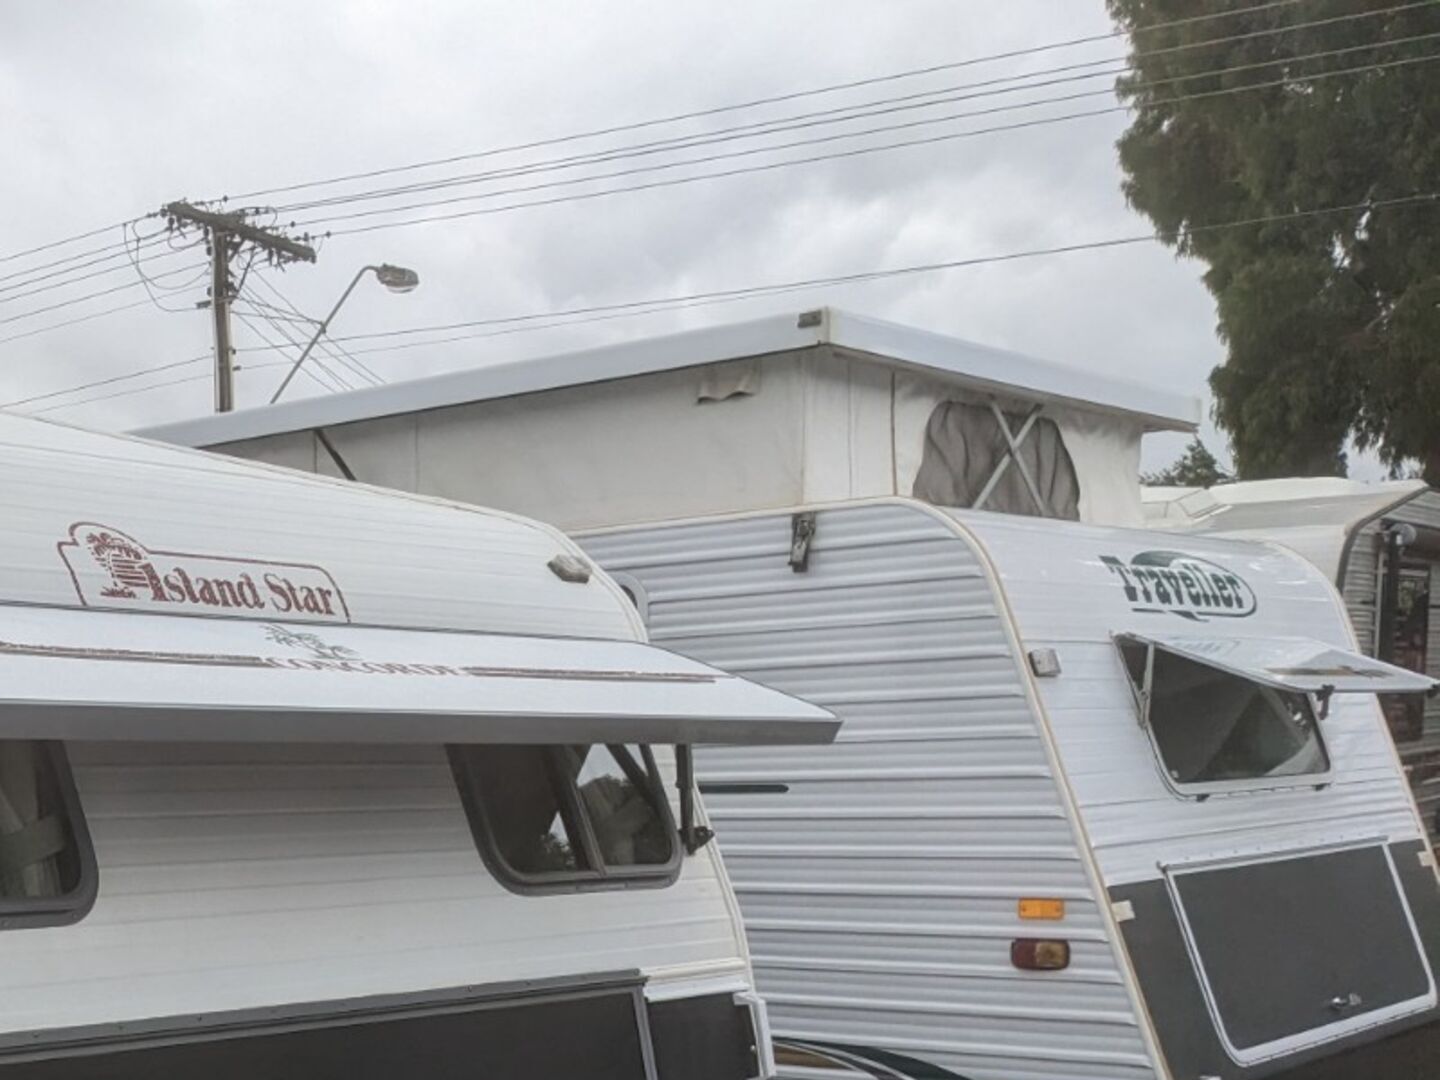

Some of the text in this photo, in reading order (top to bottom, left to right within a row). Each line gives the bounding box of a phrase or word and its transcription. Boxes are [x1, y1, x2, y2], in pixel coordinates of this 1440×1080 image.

[138, 561, 337, 616] Island Star
[1098, 555, 1245, 609] Traveller
